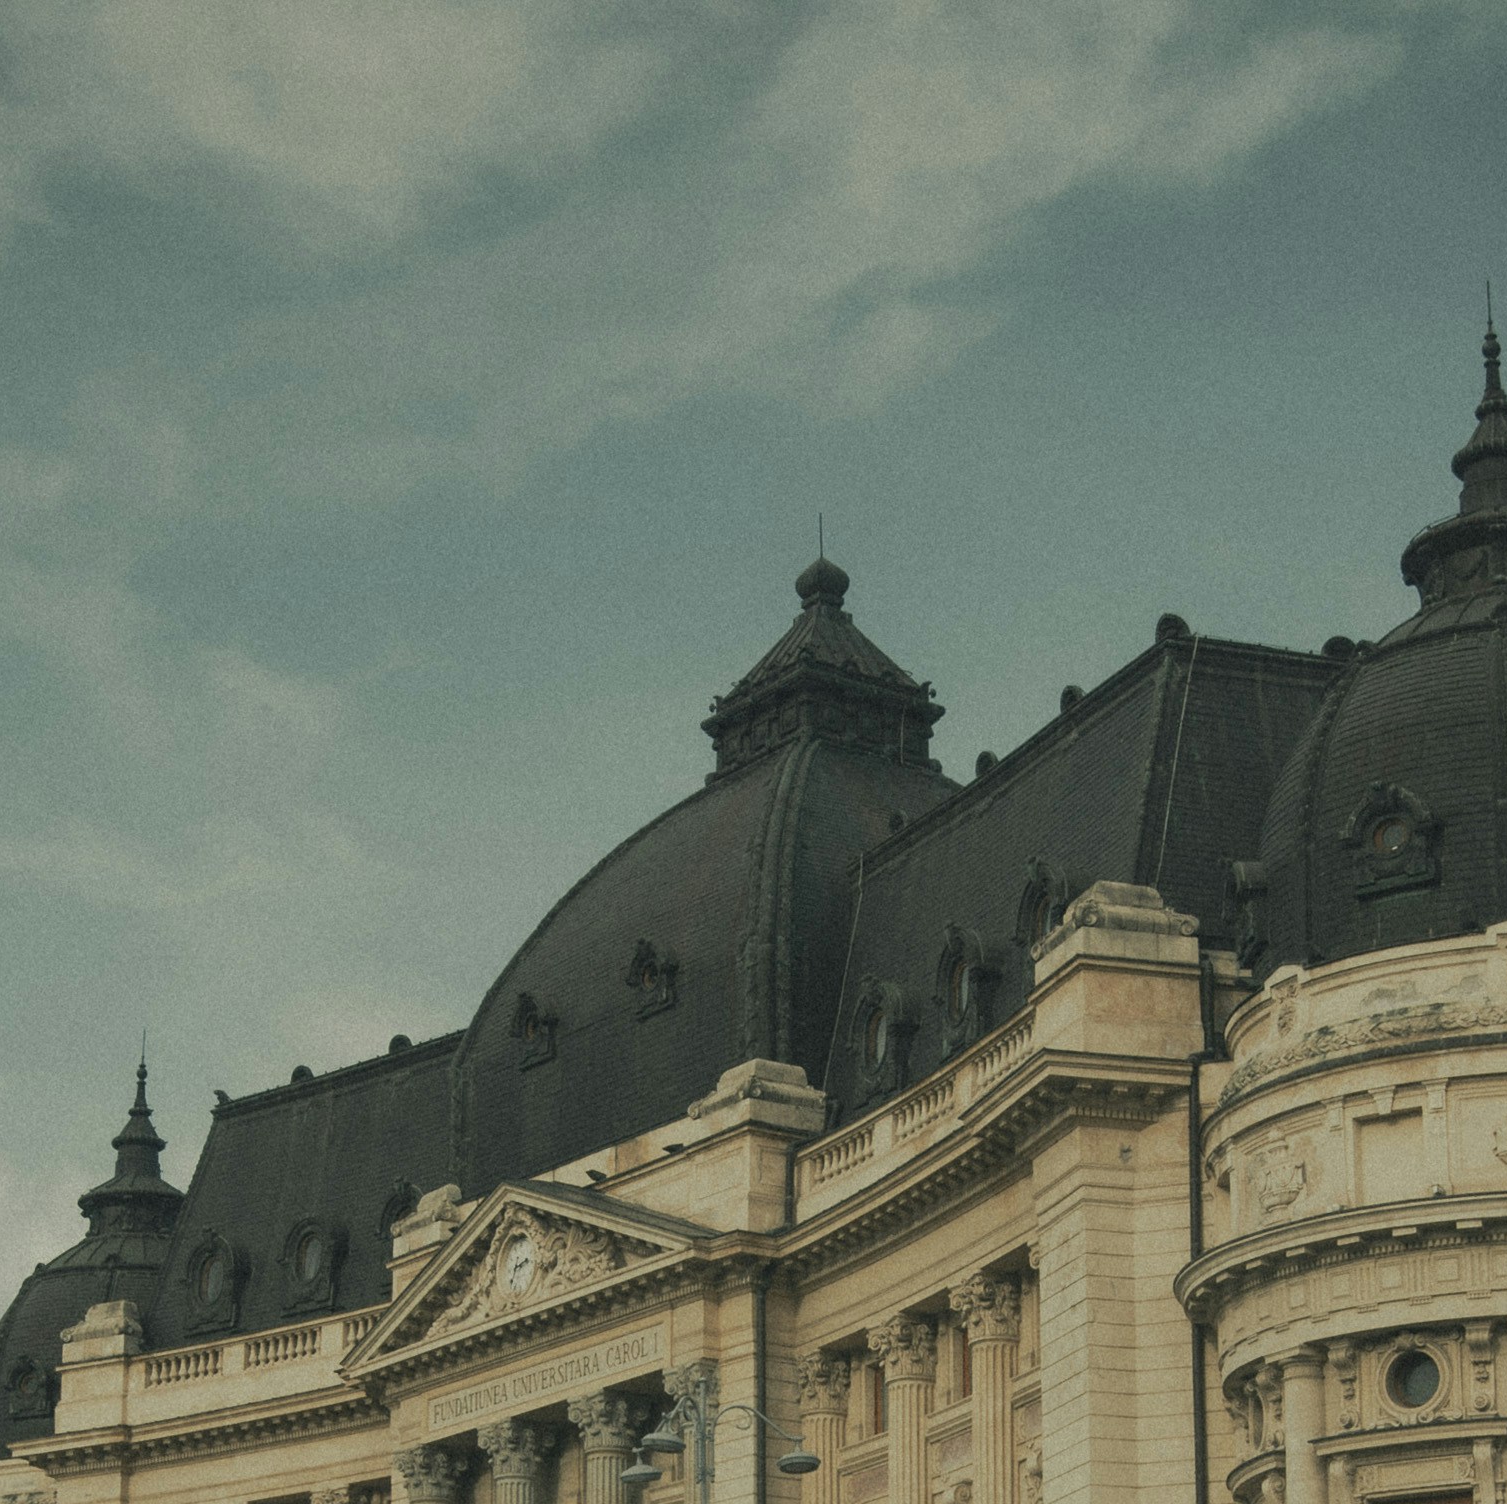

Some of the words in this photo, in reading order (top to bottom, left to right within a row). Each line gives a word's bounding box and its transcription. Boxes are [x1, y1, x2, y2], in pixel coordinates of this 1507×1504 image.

[512, 1353, 600, 1399] UNIVERSITARA
[606, 1337, 651, 1369] CAROL
[653, 1332, 659, 1355] I
